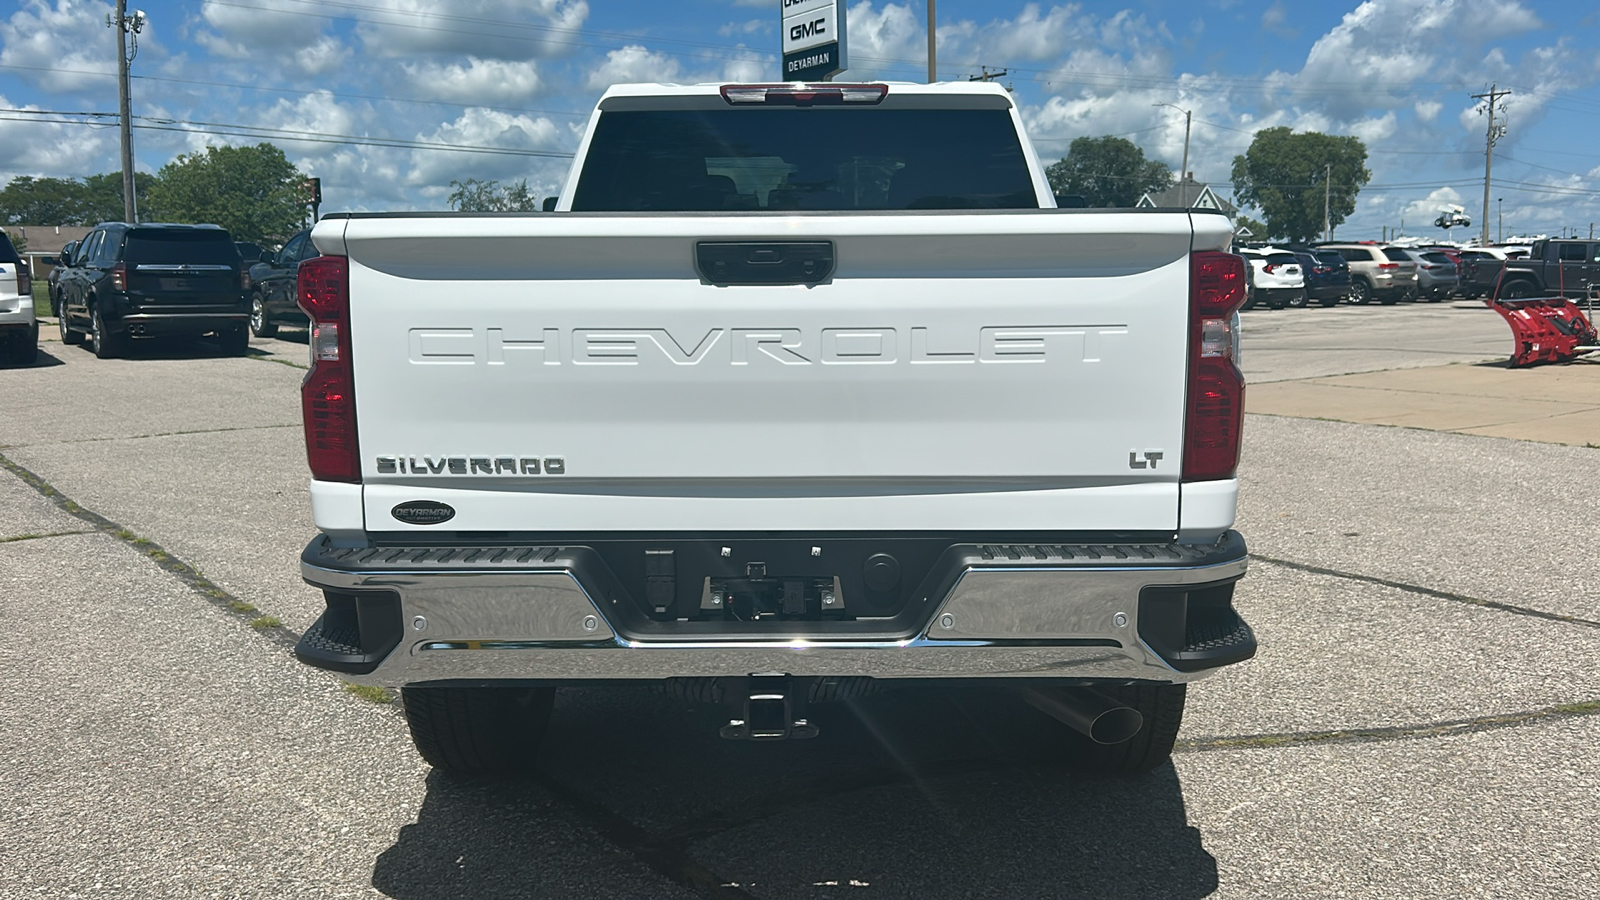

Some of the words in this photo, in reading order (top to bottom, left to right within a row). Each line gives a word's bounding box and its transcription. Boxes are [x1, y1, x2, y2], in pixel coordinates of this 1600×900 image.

[790, 18, 825, 41] GMC
[788, 52, 830, 72] DEYARMAN
[408, 325, 1129, 366] CHEVROLET
[376, 455, 566, 475] SILVERADO
[1128, 450, 1164, 469] LT
[396, 508, 451, 516] DEYARMAN
